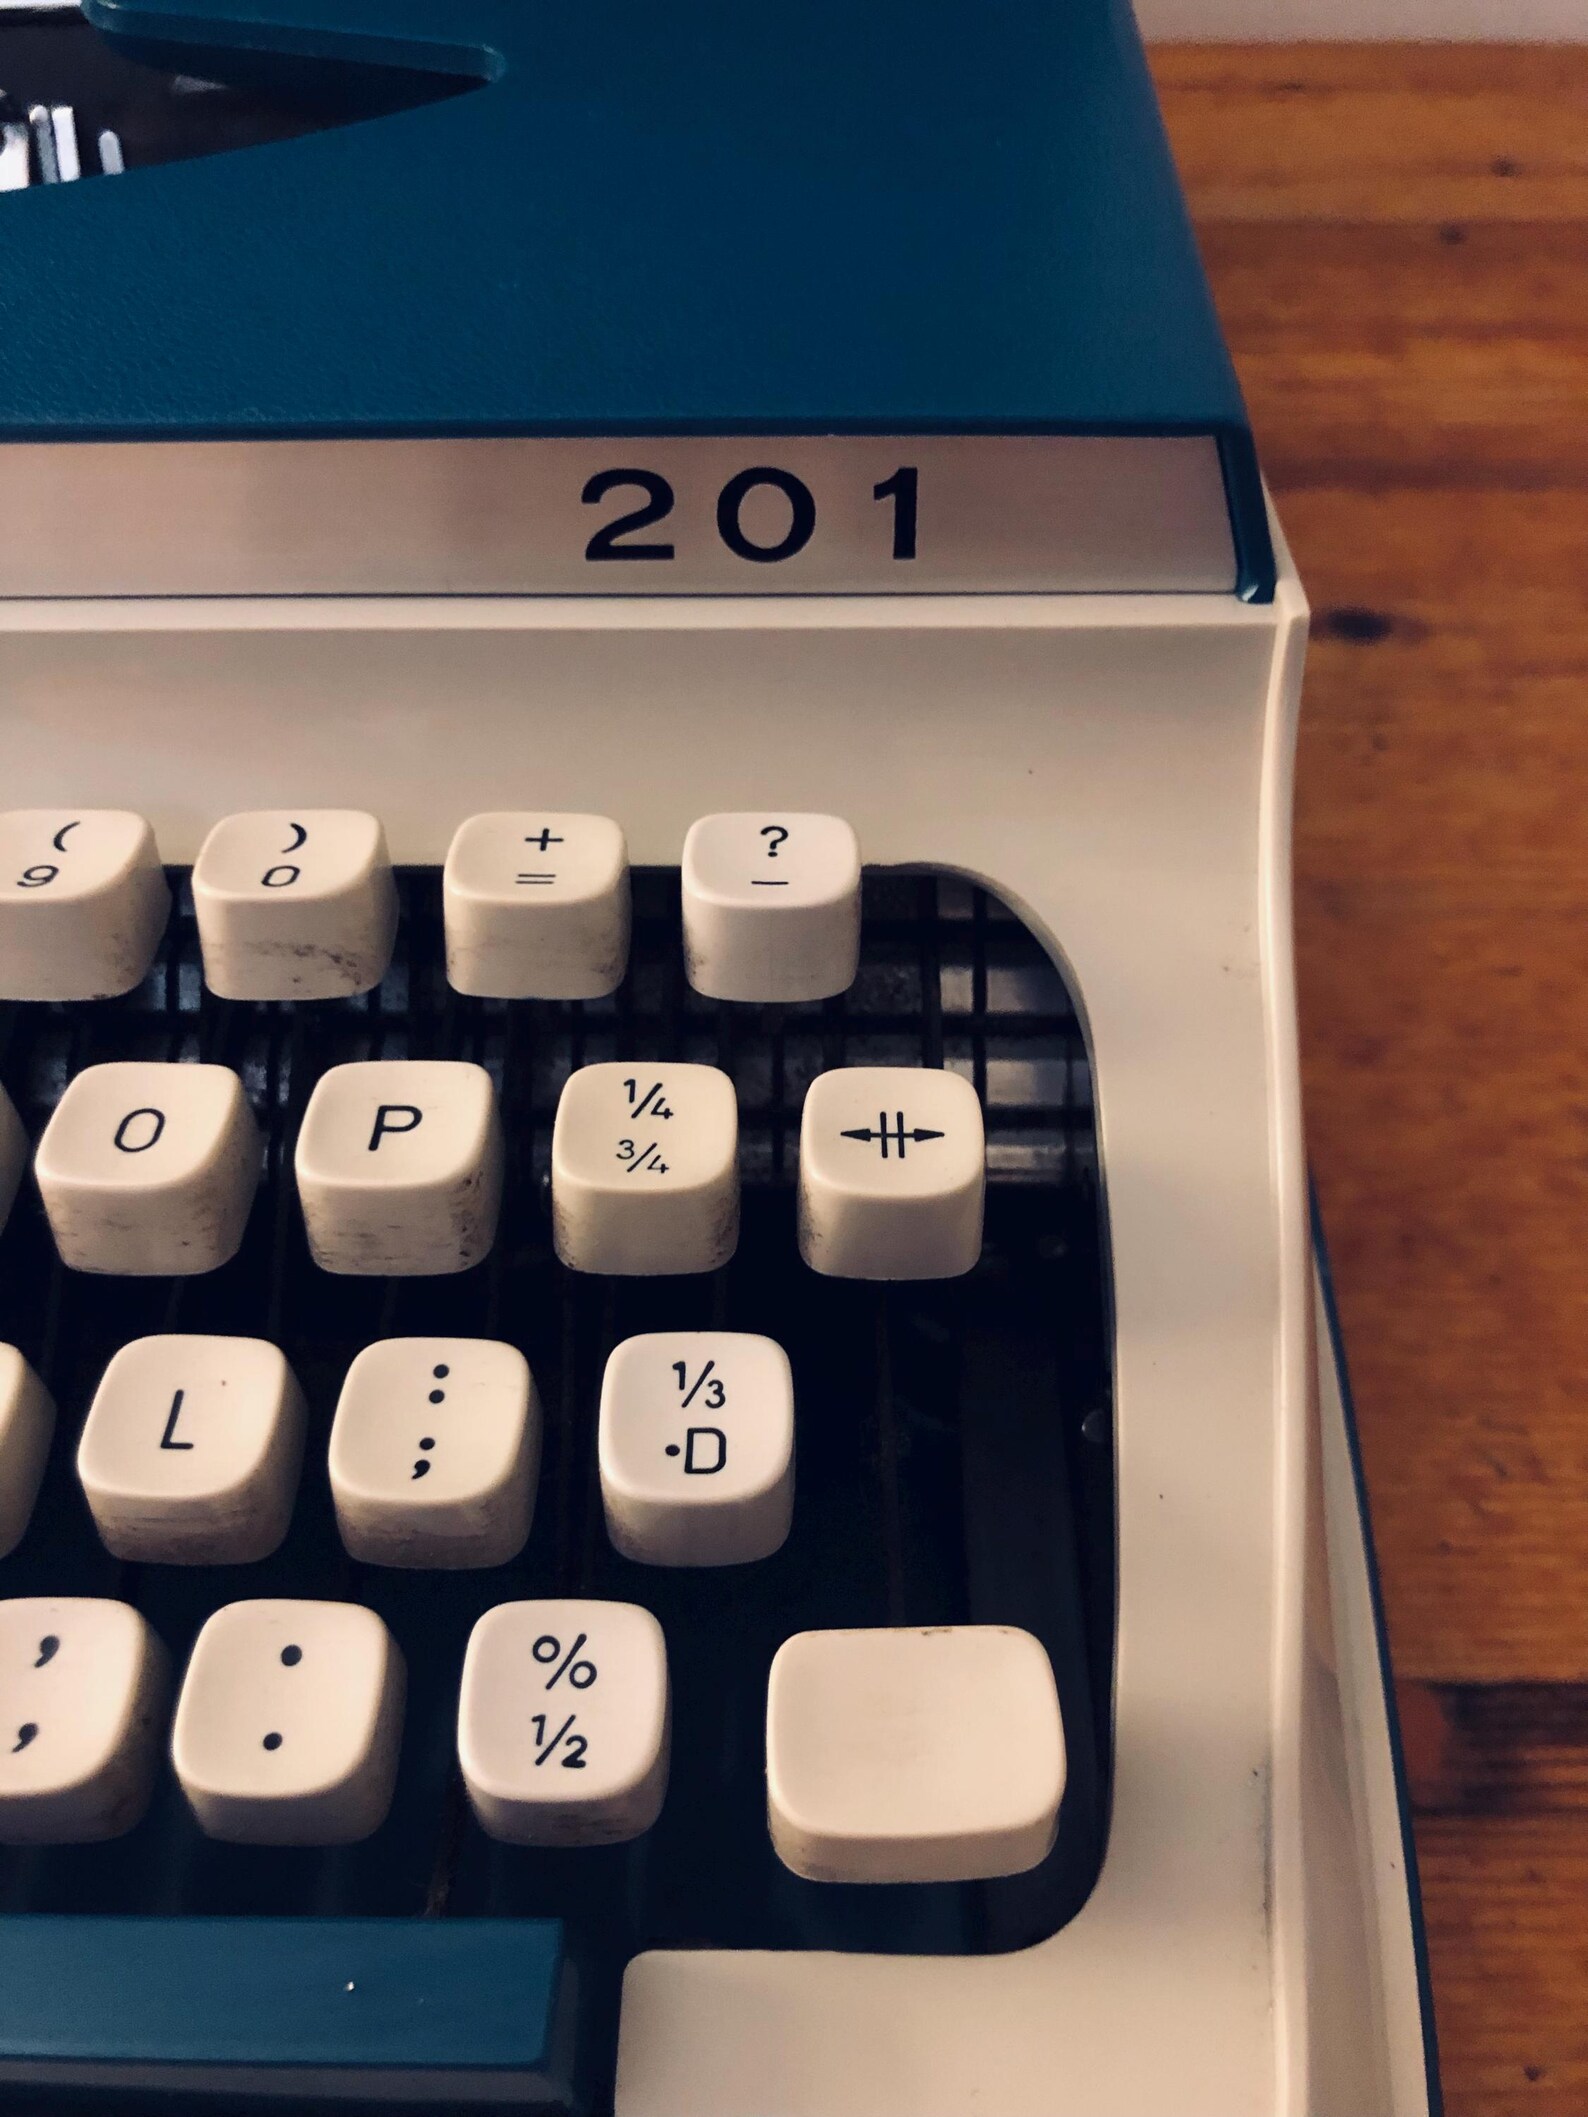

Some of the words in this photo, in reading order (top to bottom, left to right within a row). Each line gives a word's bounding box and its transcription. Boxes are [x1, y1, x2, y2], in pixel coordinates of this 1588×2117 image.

[581, 466, 918, 562] 201
[53, 822, 79, 852] (
[282, 823, 307, 853] )
[761, 826, 788, 857] ?
[17, 865, 59, 887] 9
[114, 1108, 165, 1153] O
[368, 1105, 422, 1151] P
[160, 1390, 194, 1450] L
[532, 1634, 597, 1690] %
